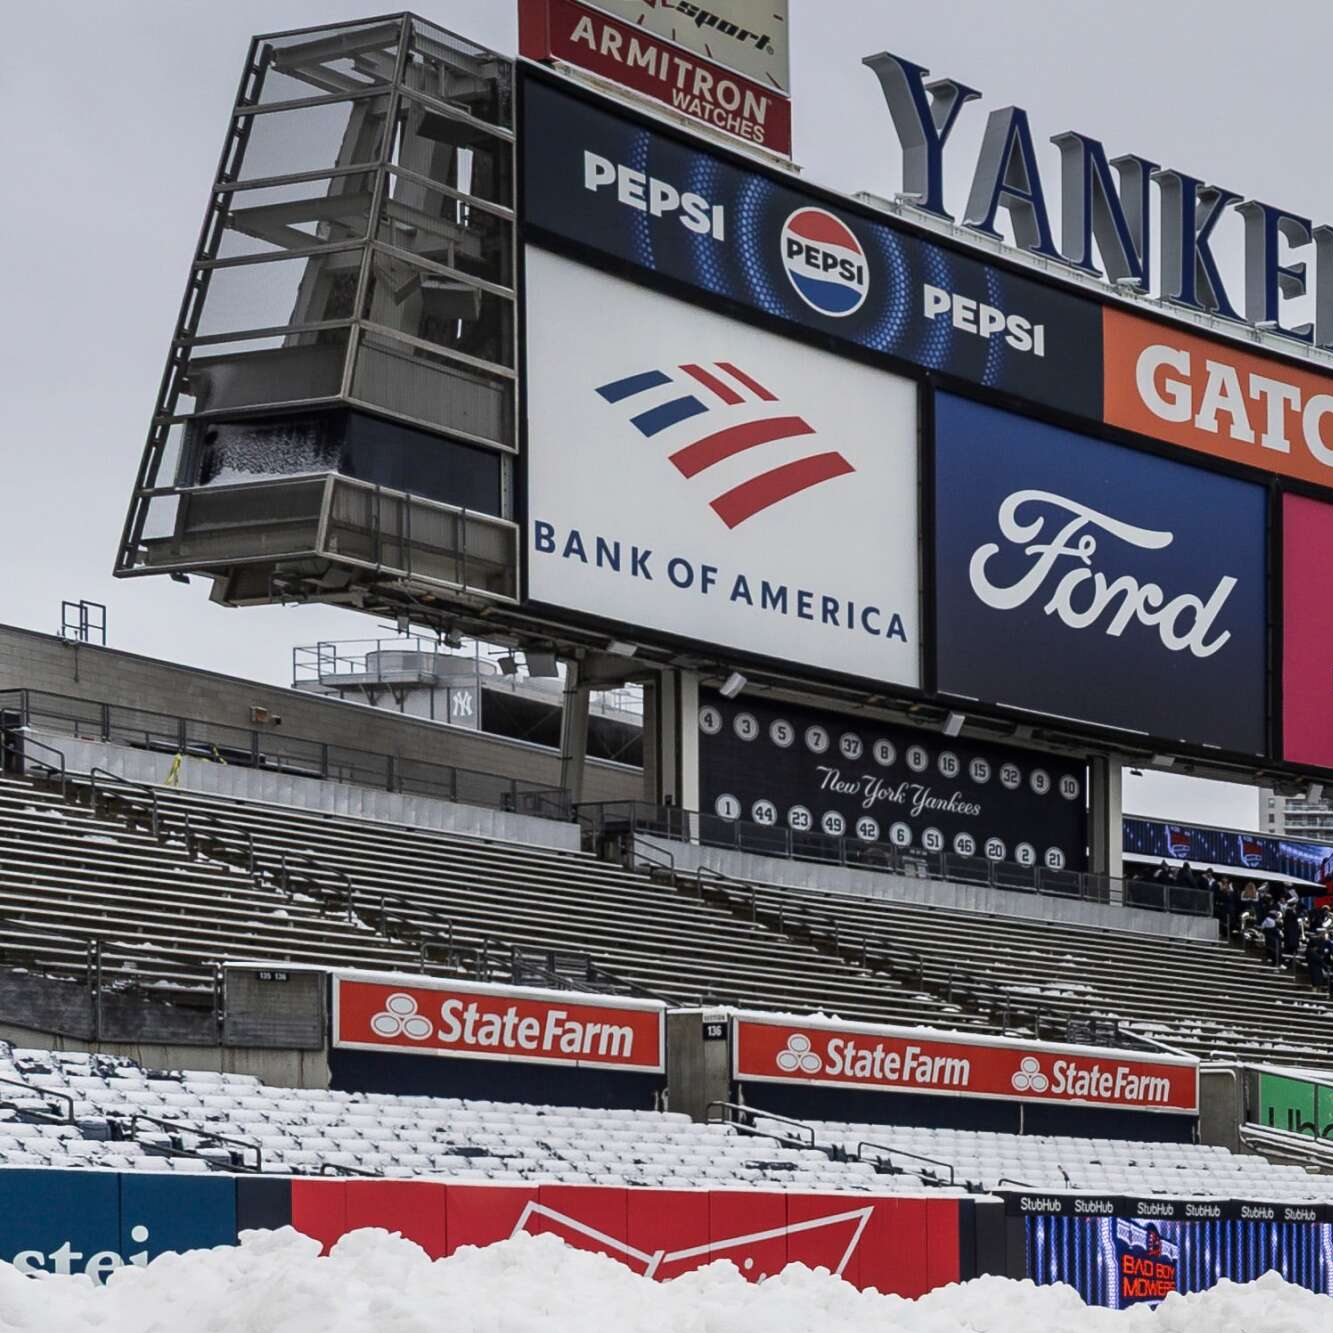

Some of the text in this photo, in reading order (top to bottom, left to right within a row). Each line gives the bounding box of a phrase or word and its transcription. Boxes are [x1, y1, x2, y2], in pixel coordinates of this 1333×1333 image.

[570, 16, 768, 124] ARMITRON
[672, 88, 765, 143] WATCHES
[584, 150, 724, 242] PEPSI
[786, 240, 864, 286] PEPSI
[923, 284, 1046, 358] PEPSI
[533, 520, 908, 644] BANK OF AMERICA
[969, 489, 1238, 658] Ford
[703, 712, 714, 728] 4
[741, 719, 751, 735] 3
[777, 726, 787, 741] 5
[812, 732, 822, 747] 7
[843, 738, 860, 754] 37
[880, 745, 889, 760] 8
[913, 752, 922, 766] 8
[943, 757, 956, 773] 16
[974, 763, 987, 778] 15
[1003, 768, 1019, 784] 32
[1063, 780, 1076, 794] 10
[816, 765, 981, 817] New York Yankees
[724, 801, 1061, 868] 1 44 23 49 42 6 51 46 20 2 21
[1021, 1198, 1061, 1212] StubHub
[1074, 1200, 1114, 1214] StubHub
[1138, 1202, 1174, 1216] StubHub
[1186, 1203, 1221, 1217] StubHub
[1122, 1255, 1175, 1279] BAD BOY
